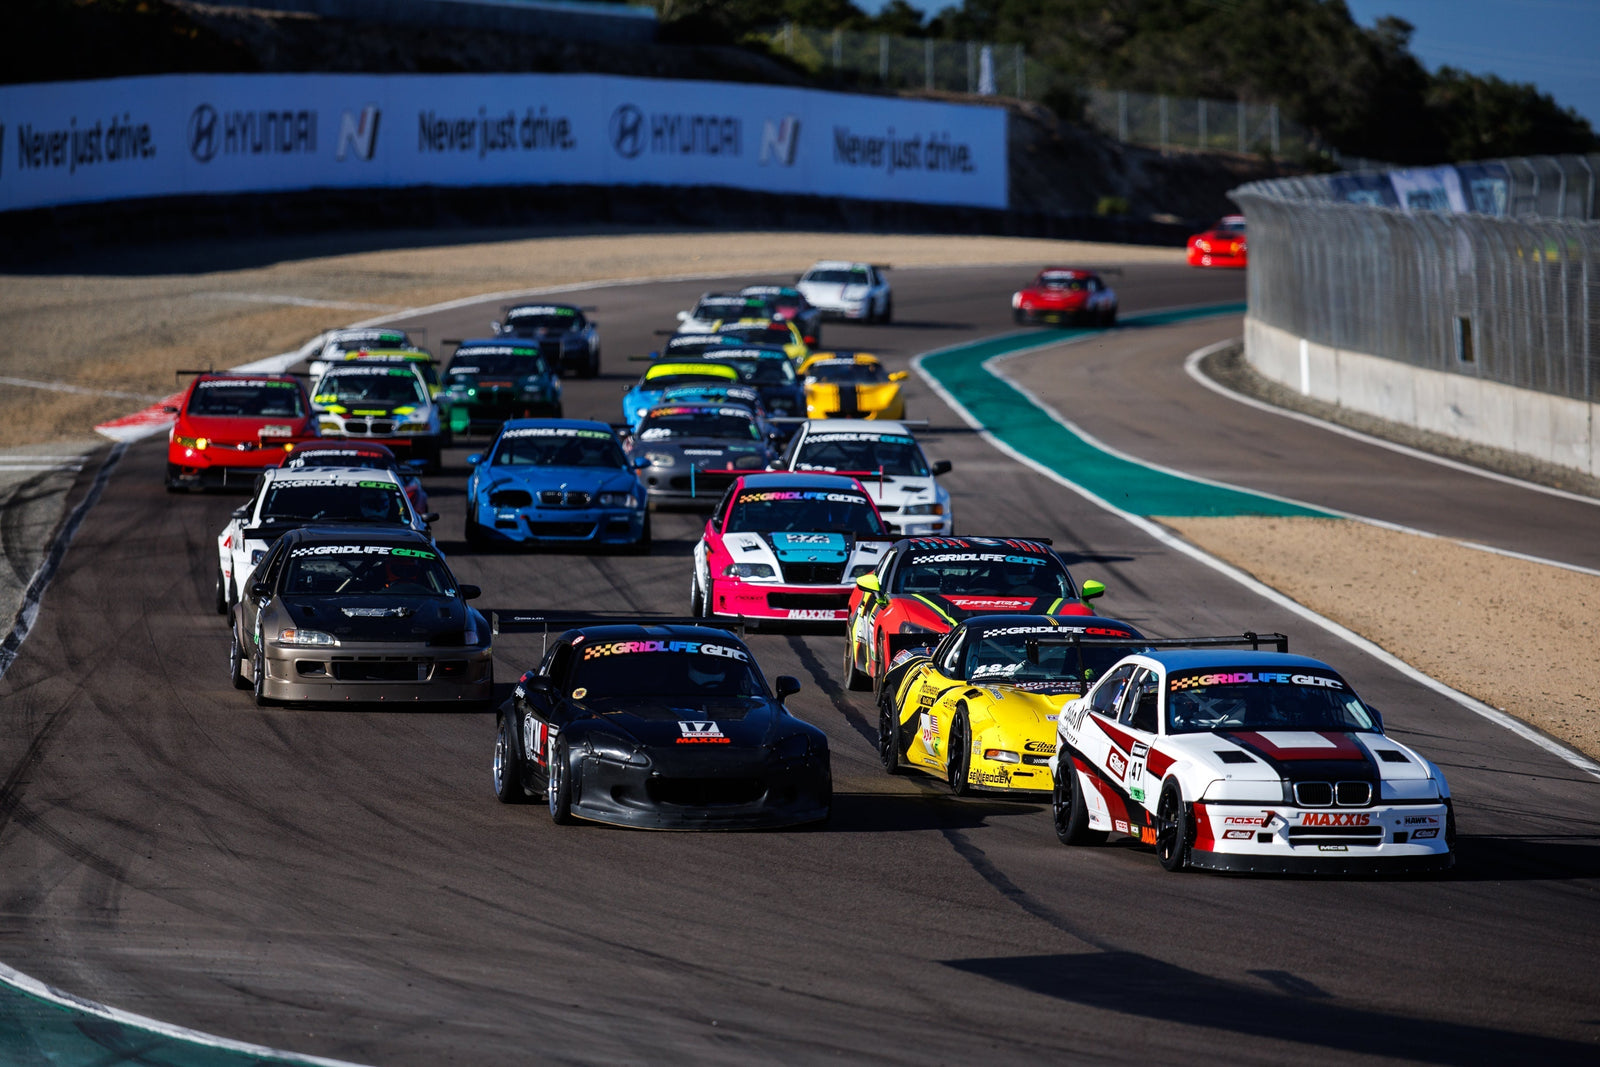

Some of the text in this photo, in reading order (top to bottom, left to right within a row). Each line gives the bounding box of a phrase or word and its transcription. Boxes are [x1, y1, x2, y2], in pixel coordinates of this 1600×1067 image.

[224, 110, 318, 154] HYUNDAI
[418, 104, 576, 160] Never just drive.
[650, 114, 742, 155] HYUNDAI
[18, 112, 155, 174] Never just drive.
[833, 125, 976, 174] Never just drive.
[359, 481, 397, 490] GLTC
[760, 492, 867, 504] GRIDLIFE GLTC
[313, 546, 436, 559] GRIDLIFE GLTC
[933, 553, 1047, 566] GRIDLIFE GLTC
[787, 610, 835, 619] MAXXIS
[1006, 626, 1131, 638] GRIDLIFE GLTC
[610, 640, 749, 662] GRIDLIFE GLTC
[973, 664, 1016, 674] 484
[1198, 673, 1344, 690] GRIDLIFE GLTC
[679, 721, 714, 732] 17
[1132, 762, 1143, 781] 47
[1224, 817, 1265, 825] nasa
[1302, 813, 1370, 826] MAXXIS
